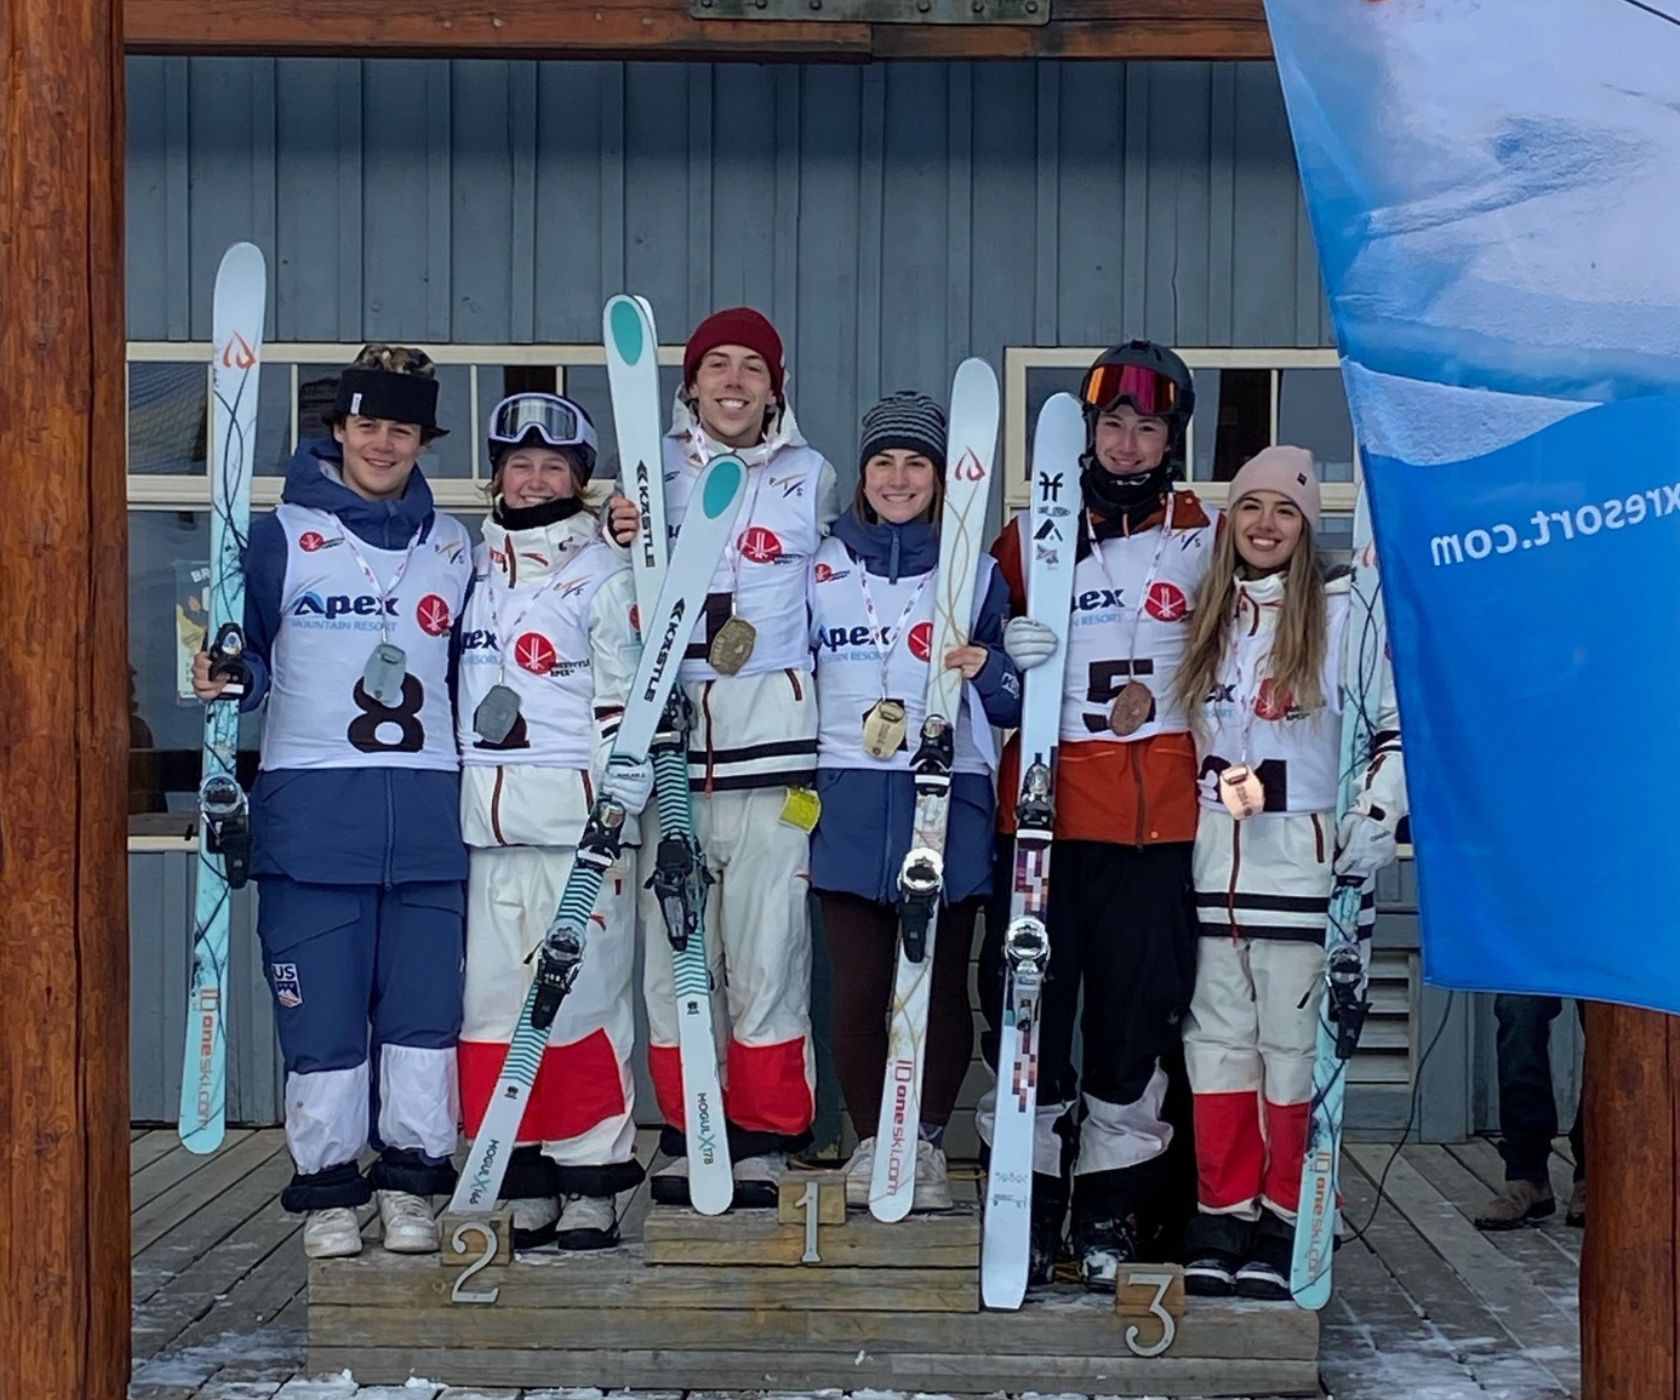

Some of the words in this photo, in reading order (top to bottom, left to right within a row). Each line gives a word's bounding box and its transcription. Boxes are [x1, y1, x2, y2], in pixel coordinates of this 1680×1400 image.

[294, 592, 400, 619] Apex
[347, 671, 425, 753] 8
[273, 964, 295, 980] US
[451, 1222, 498, 1303] 2
[795, 1181, 821, 1263] 1
[1125, 1273, 1177, 1357] 3
